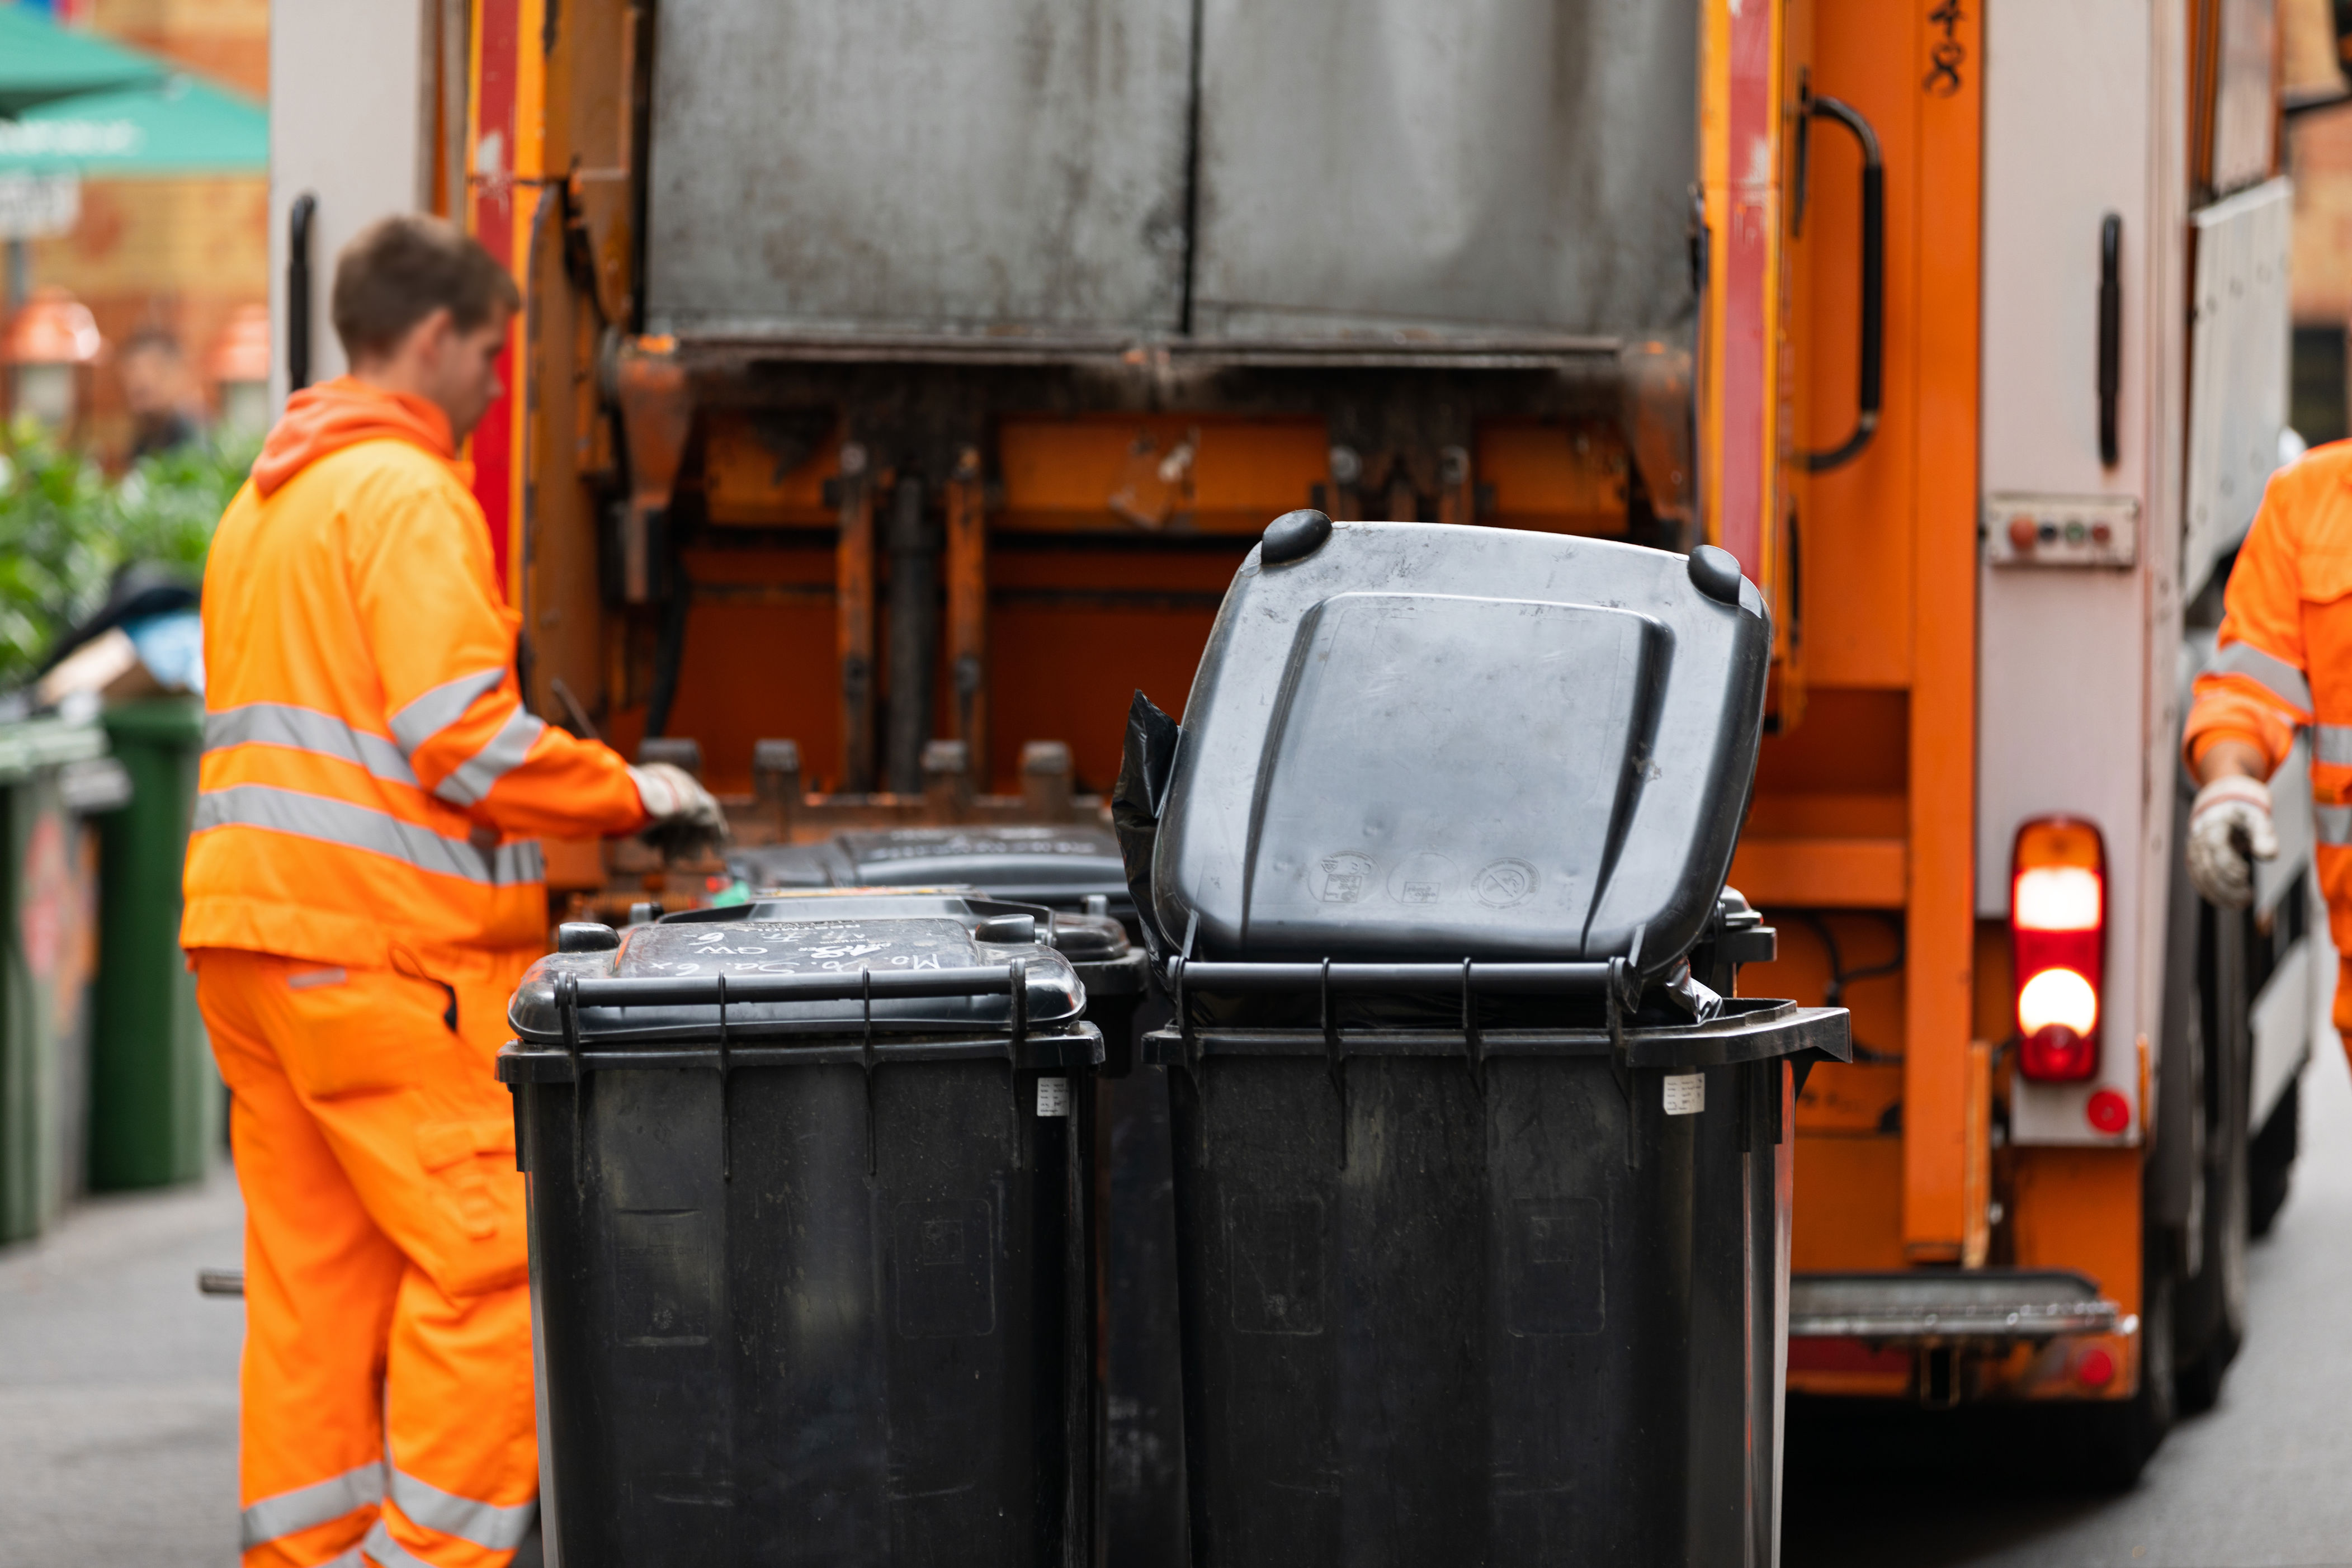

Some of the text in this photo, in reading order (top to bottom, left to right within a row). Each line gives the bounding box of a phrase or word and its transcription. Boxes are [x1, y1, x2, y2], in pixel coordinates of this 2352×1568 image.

[693, 946, 768, 955] GW
[882, 953, 941, 970] Mo.
[725, 962, 801, 974] Sa.
